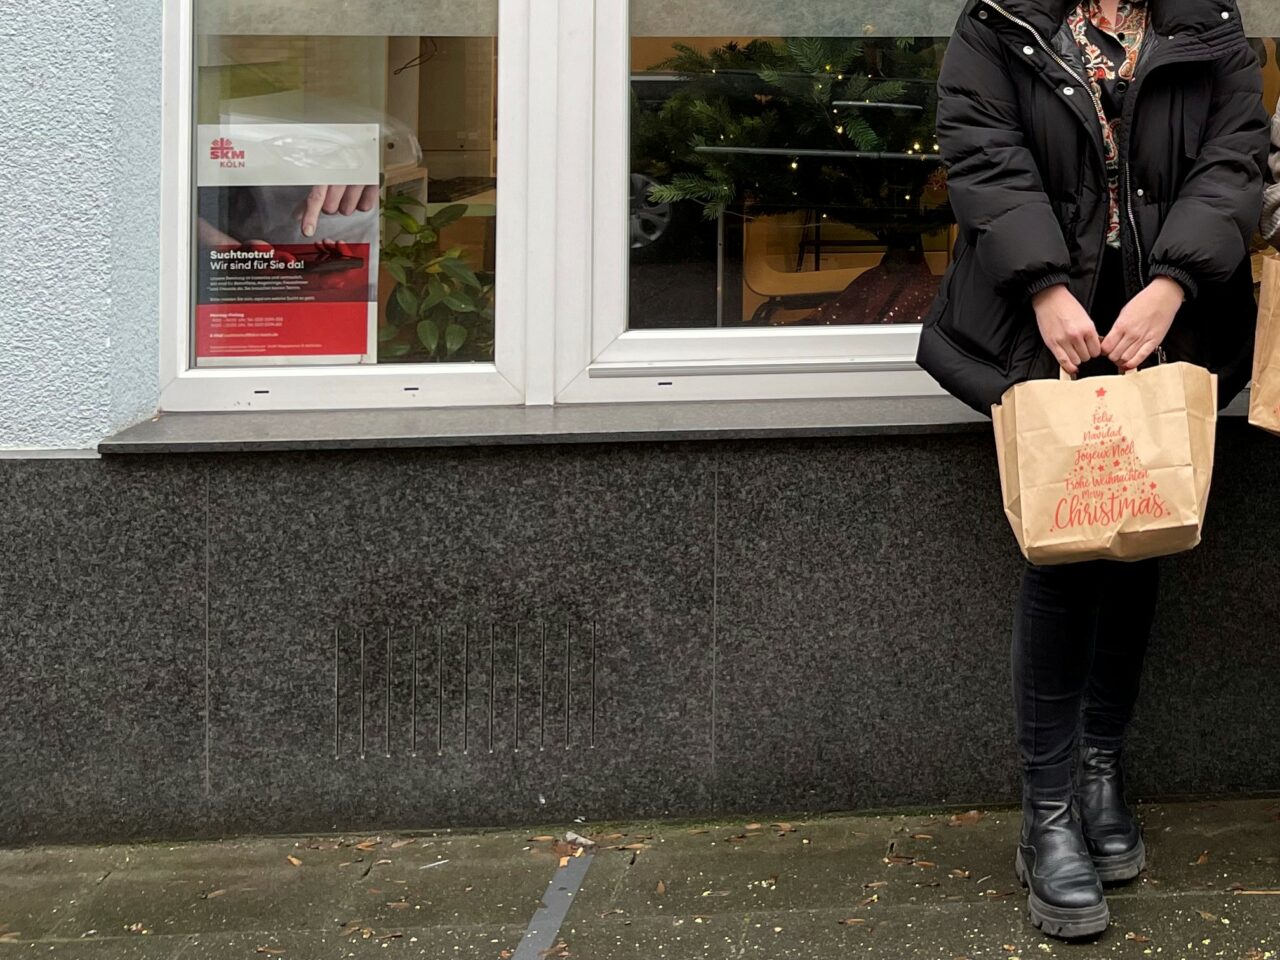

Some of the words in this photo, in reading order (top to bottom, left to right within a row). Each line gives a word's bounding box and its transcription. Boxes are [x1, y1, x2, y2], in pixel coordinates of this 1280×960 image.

[210, 149, 245, 160] SKM
[219, 160, 245, 168] KÖLN
[209, 249, 275, 260] Suchtnotruf
[210, 260, 228, 270] Wir
[230, 260, 251, 270] sind
[253, 259, 268, 270] für
[269, 260, 285, 270] Sie
[287, 259, 304, 270] da!
[1093, 412, 1114, 424] Feliz
[1083, 426, 1122, 442] Navidad
[1074, 448, 1111, 465] Joyeux
[1112, 440, 1135, 458] Noël
[1064, 477, 1089, 490] Frohe
[1092, 469, 1149, 487] Weihnachten
[1055, 493, 1165, 529] Christmas
